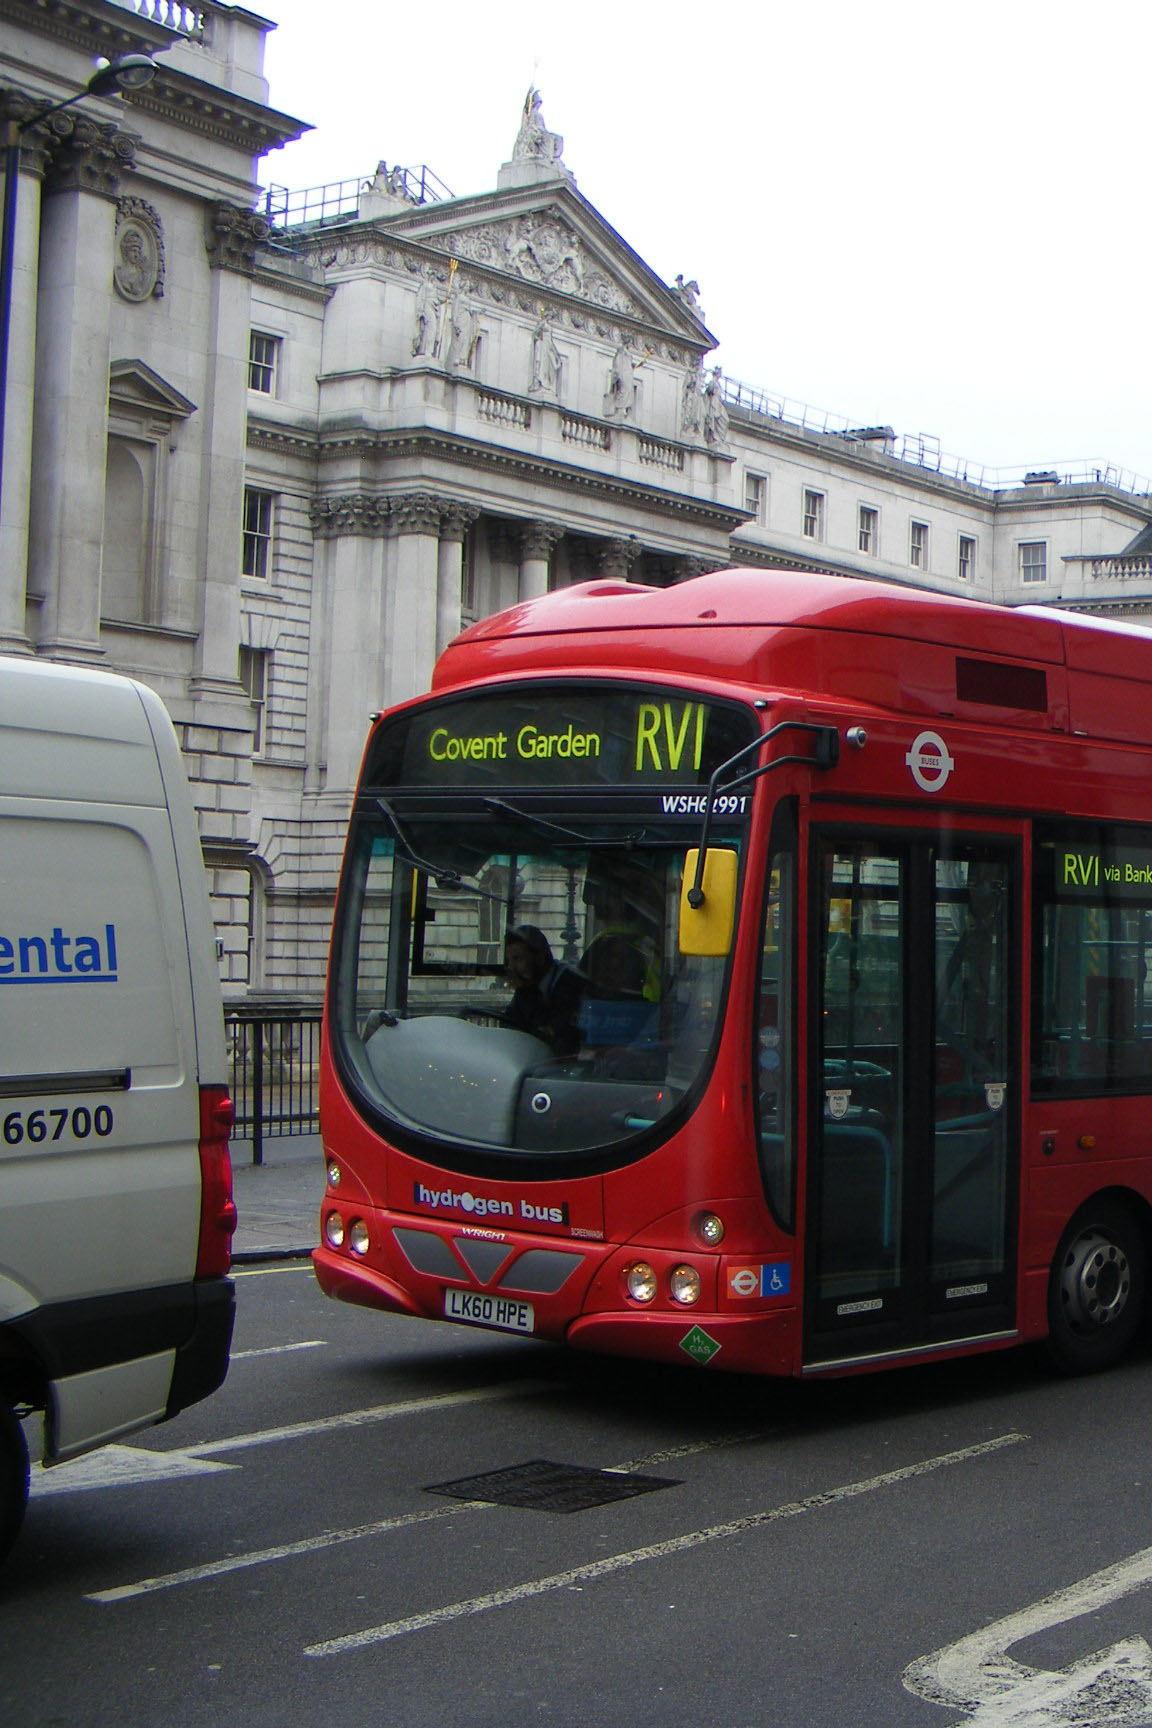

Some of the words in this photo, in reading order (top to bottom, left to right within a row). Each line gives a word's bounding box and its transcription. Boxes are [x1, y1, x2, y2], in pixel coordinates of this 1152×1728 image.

[429, 728, 507, 761] Covent
[517, 724, 600, 760] Garden
[921, 757, 939, 766] BUSES
[1104, 864, 1120, 882] via
[4, 1105, 114, 1145] 66700
[419, 1185, 514, 1216] hydrogen
[520, 1200, 563, 1224] bus
[461, 1227, 507, 1241] WRIGHT
[571, 1227, 604, 1239] SCREENWASH
[948, 1287, 975, 1297] EMERGENCY
[451, 1293, 493, 1321] LK60
[497, 1299, 528, 1326] HPE
[839, 1301, 869, 1314] EMERGENCY
[689, 1345, 711, 1354] GAS
